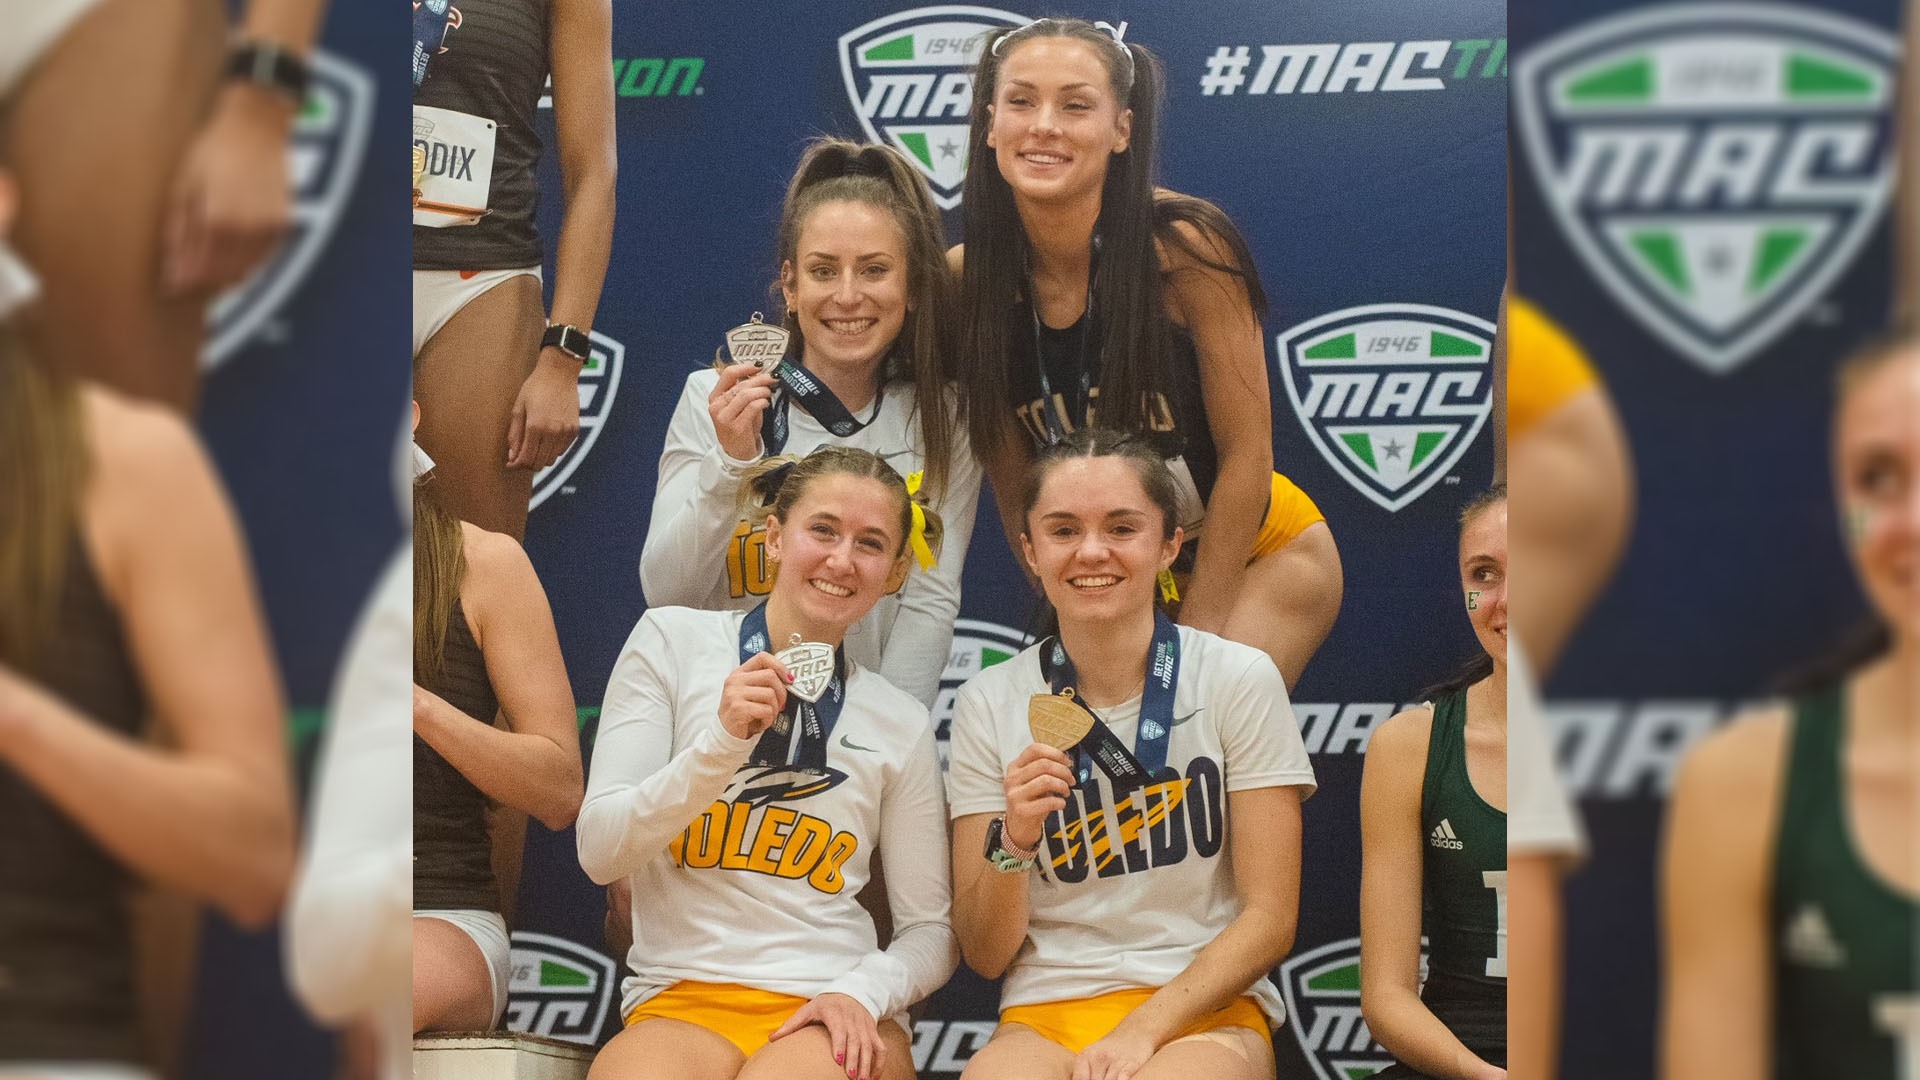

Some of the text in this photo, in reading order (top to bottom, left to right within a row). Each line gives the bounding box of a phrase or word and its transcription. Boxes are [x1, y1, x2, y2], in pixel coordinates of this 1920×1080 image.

[863, 73, 974, 119] MA
[1368, 336, 1422, 353] 1946
[1302, 371, 1485, 418] MAC
[1036, 755, 1223, 884] OLEDO
[1431, 837, 1464, 850] adidas
